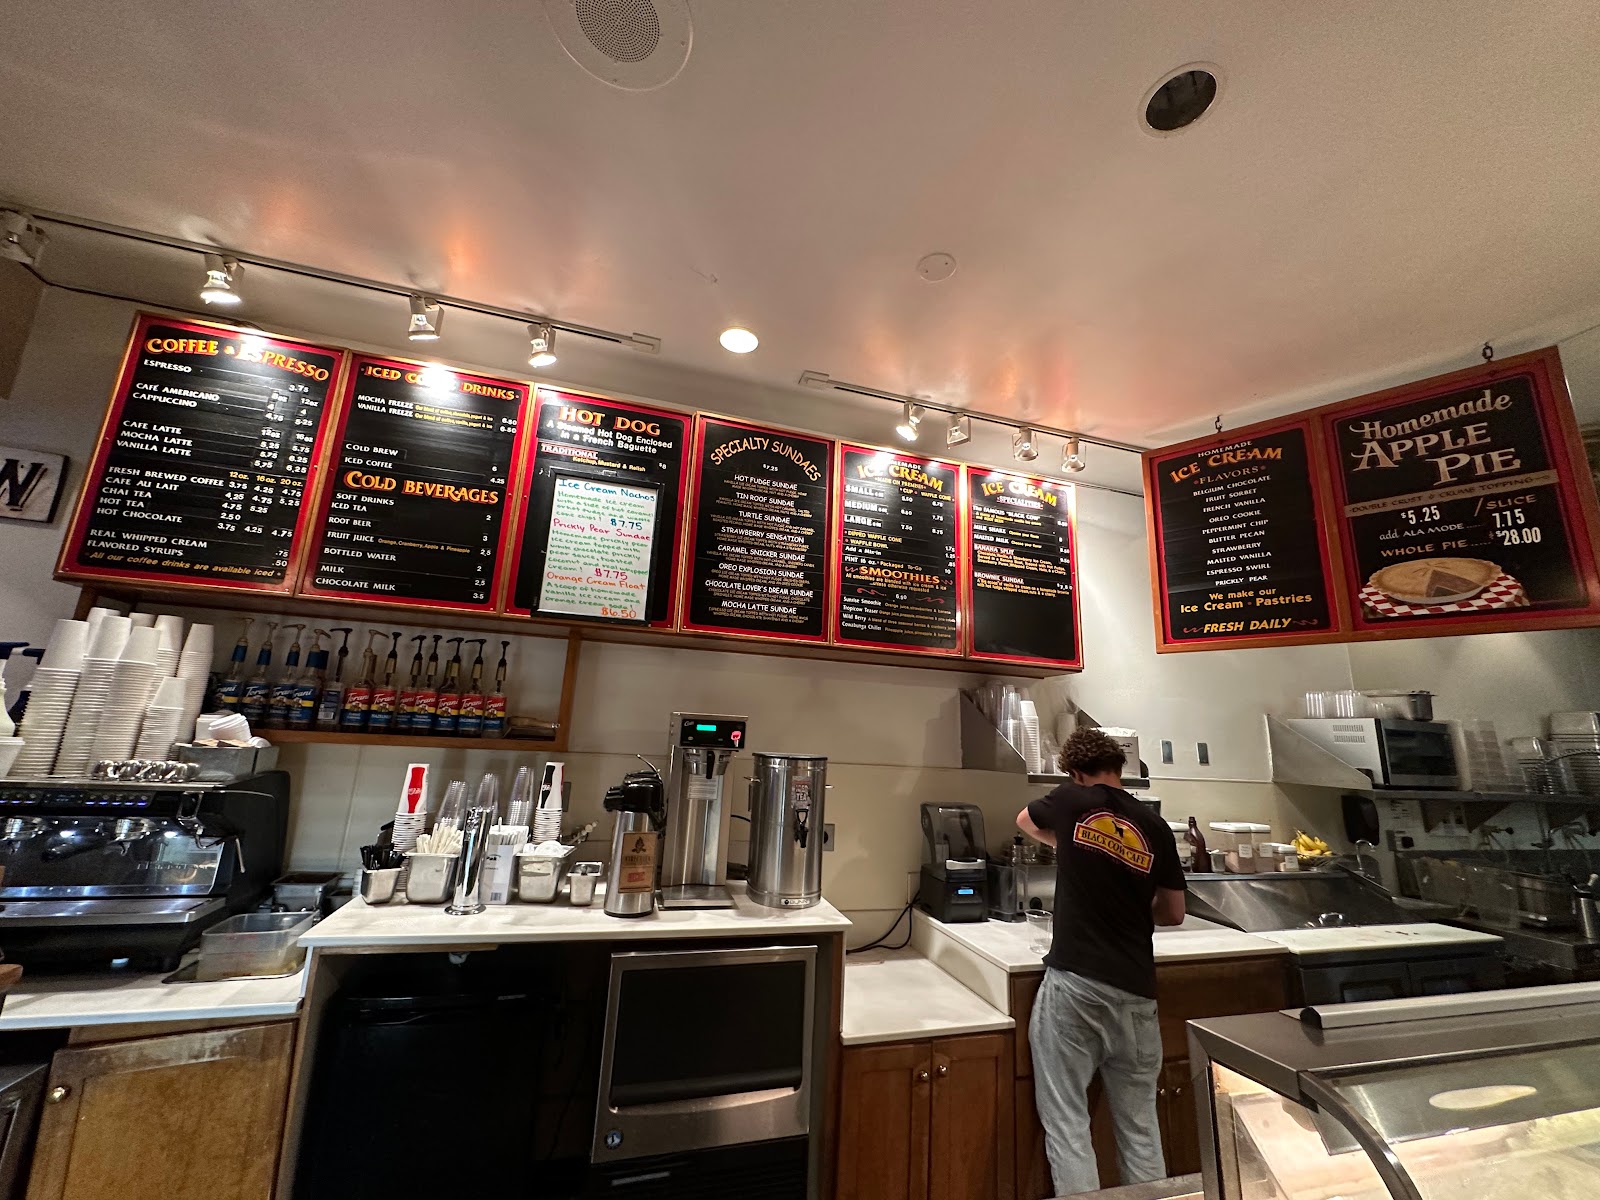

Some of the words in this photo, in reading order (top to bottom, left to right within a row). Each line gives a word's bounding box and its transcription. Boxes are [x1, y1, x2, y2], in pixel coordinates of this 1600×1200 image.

[145, 338, 219, 355] COFFEE
[144, 359, 192, 373] ESPRESSO
[289, 384, 309, 393] 3.75
[162, 387, 220, 401] AMERICANO
[460, 382, 515, 401] DRINKS
[133, 392, 197, 407] CAPPUCCINO
[358, 395, 385, 404] MOCHA
[388, 400, 413, 409] FREEZE
[358, 403, 386, 412] VANILLA
[1349, 389, 1513, 439] Homemade
[123, 420, 148, 429] CAFE
[153, 424, 182, 434] LATTE
[560, 405, 605, 426] HOT
[613, 416, 661, 436] DOG
[121, 431, 159, 441] MOCHA
[164, 437, 192, 446] LATTE
[557, 421, 595, 435] Steamed
[598, 429, 613, 438] Hot
[616, 432, 633, 442] Dog
[636, 436, 673, 449] Enclosed
[117, 440, 158, 451] VANILLA
[162, 446, 191, 456] LATTE
[346, 443, 370, 452] COLD
[373, 447, 398, 456] BREW
[582, 433, 614, 446] French
[617, 440, 657, 454] Baguette
[1198, 441, 1253, 458] HOMEMADE
[1351, 422, 1491, 471] APPLE
[541, 444, 599, 460] TRADITIONAL
[710, 437, 769, 465] SPECIALTY
[771, 441, 822, 481] SUNDAES
[366, 460, 392, 468] COFFEE
[1169, 462, 1201, 483] ICE
[1207, 447, 1282, 467] CREAM
[1425, 448, 1521, 486] PIE
[108, 466, 140, 475] FRESH
[145, 471, 187, 481] BREWED
[190, 476, 224, 487] COFFEE
[229, 481, 248, 490] 3.75
[254, 486, 274, 494] 4.25
[282, 488, 301, 497] 4.75
[888, 464, 943, 492] CREAM
[1200, 465, 1259, 484] FLAVORS
[344, 470, 396, 491] COLD
[401, 480, 498, 504] BEVERAGES
[559, 479, 580, 489] Ice
[584, 482, 617, 495] Cream
[621, 488, 655, 501] Nachos
[750, 477, 771, 486] FUDGE
[772, 481, 798, 490] SUNDAE
[845, 485, 874, 495] SMALL
[981, 482, 1004, 496] ICE
[1193, 486, 1224, 496] BELGIUM
[1227, 475, 1271, 489] CHOCOLATE
[102, 487, 129, 495] CHAI
[134, 490, 152, 498] TEA
[105, 477, 131, 485] CAFE
[136, 480, 152, 488] AU
[156, 482, 179, 491] LAIT
[225, 492, 244, 500] 4.25
[252, 495, 272, 504] 4.75
[279, 498, 300, 506] 5.25
[1229, 488, 1257, 498] SORBET
[100, 497, 121, 505] HOT
[126, 500, 144, 508] TEA
[336, 493, 358, 501] SOFT
[361, 495, 394, 505] DRINKS
[844, 500, 879, 512] MEDIUM
[1234, 498, 1266, 507] VANILLA
[97, 507, 119, 515] HOT
[122, 510, 182, 523] CHOCOLATE
[353, 504, 367, 512] TEA
[1232, 510, 1261, 519] COOKIE
[1401, 505, 1441, 525] $5.25
[739, 511, 762, 520] TURTLE
[553, 518, 585, 532] Prickly
[589, 524, 611, 534] Pear
[616, 529, 651, 541] Sundae
[610, 519, 643, 530] $7.75
[1202, 523, 1247, 534] PEPPERMINT
[90, 529, 116, 538] REAL
[122, 532, 167, 543] WHIPPED
[171, 538, 208, 548] CREAM
[327, 531, 350, 540] FRUIT
[721, 527, 764, 537] STRAWBERRY
[766, 533, 804, 543] SENSATION
[1209, 534, 1236, 543] BUTTER
[1379, 529, 1400, 541] add
[1427, 523, 1464, 534] MODE
[87, 540, 139, 551] FLAVORED
[144, 546, 183, 556] SYRUPS
[1212, 542, 1261, 554] STRAWBERRY
[1380, 543, 1435, 557] WHOLE
[1442, 539, 1468, 551] PIE
[1495, 527, 1542, 546] $28.00
[324, 547, 362, 557] BOTTLED
[367, 552, 396, 561] WATER
[718, 545, 748, 554] CARAMEL
[1207, 556, 1236, 565] MALTED
[1239, 551, 1272, 560] VANILLA
[127, 557, 158, 565] coffee
[162, 560, 191, 569] drinks
[212, 565, 251, 575] available
[321, 565, 344, 573] MILK
[719, 563, 737, 571] OREO
[739, 565, 777, 576] EXPLOSION
[1206, 566, 1243, 576] ESPRESSO
[546, 571, 583, 583] Orange
[586, 577, 616, 586] Cream
[619, 581, 646, 590] Float
[594, 568, 628, 581] $7.75
[859, 566, 940, 584] SMOOTHIES
[974, 572, 1001, 581] BROWNIE
[316, 578, 369, 588] CHOCOLATE
[373, 583, 395, 591] MILK
[705, 580, 741, 589] CHOCOLATE
[768, 587, 789, 595] DREAM
[1215, 578, 1244, 586] PRICKLY
[1228, 590, 1254, 599] make
[721, 601, 746, 609] MOCHA
[748, 603, 768, 611] LATTE
[770, 605, 797, 614] SUNDAE
[1204, 601, 1243, 611] Cream
[1256, 594, 1312, 606] Pastries
[601, 606, 636, 618] $6.50
[1203, 621, 1244, 633] FRESH
[1249, 618, 1292, 630] DAILY
[374, 693, 396, 704] Torani
[415, 696, 437, 706] Torani
[438, 698, 459, 708] Torani
[461, 699, 482, 709] Torani
[1081, 829, 1106, 845] BLACK
[1108, 841, 1125, 855] COW
[1126, 851, 1146, 865] CAFE
